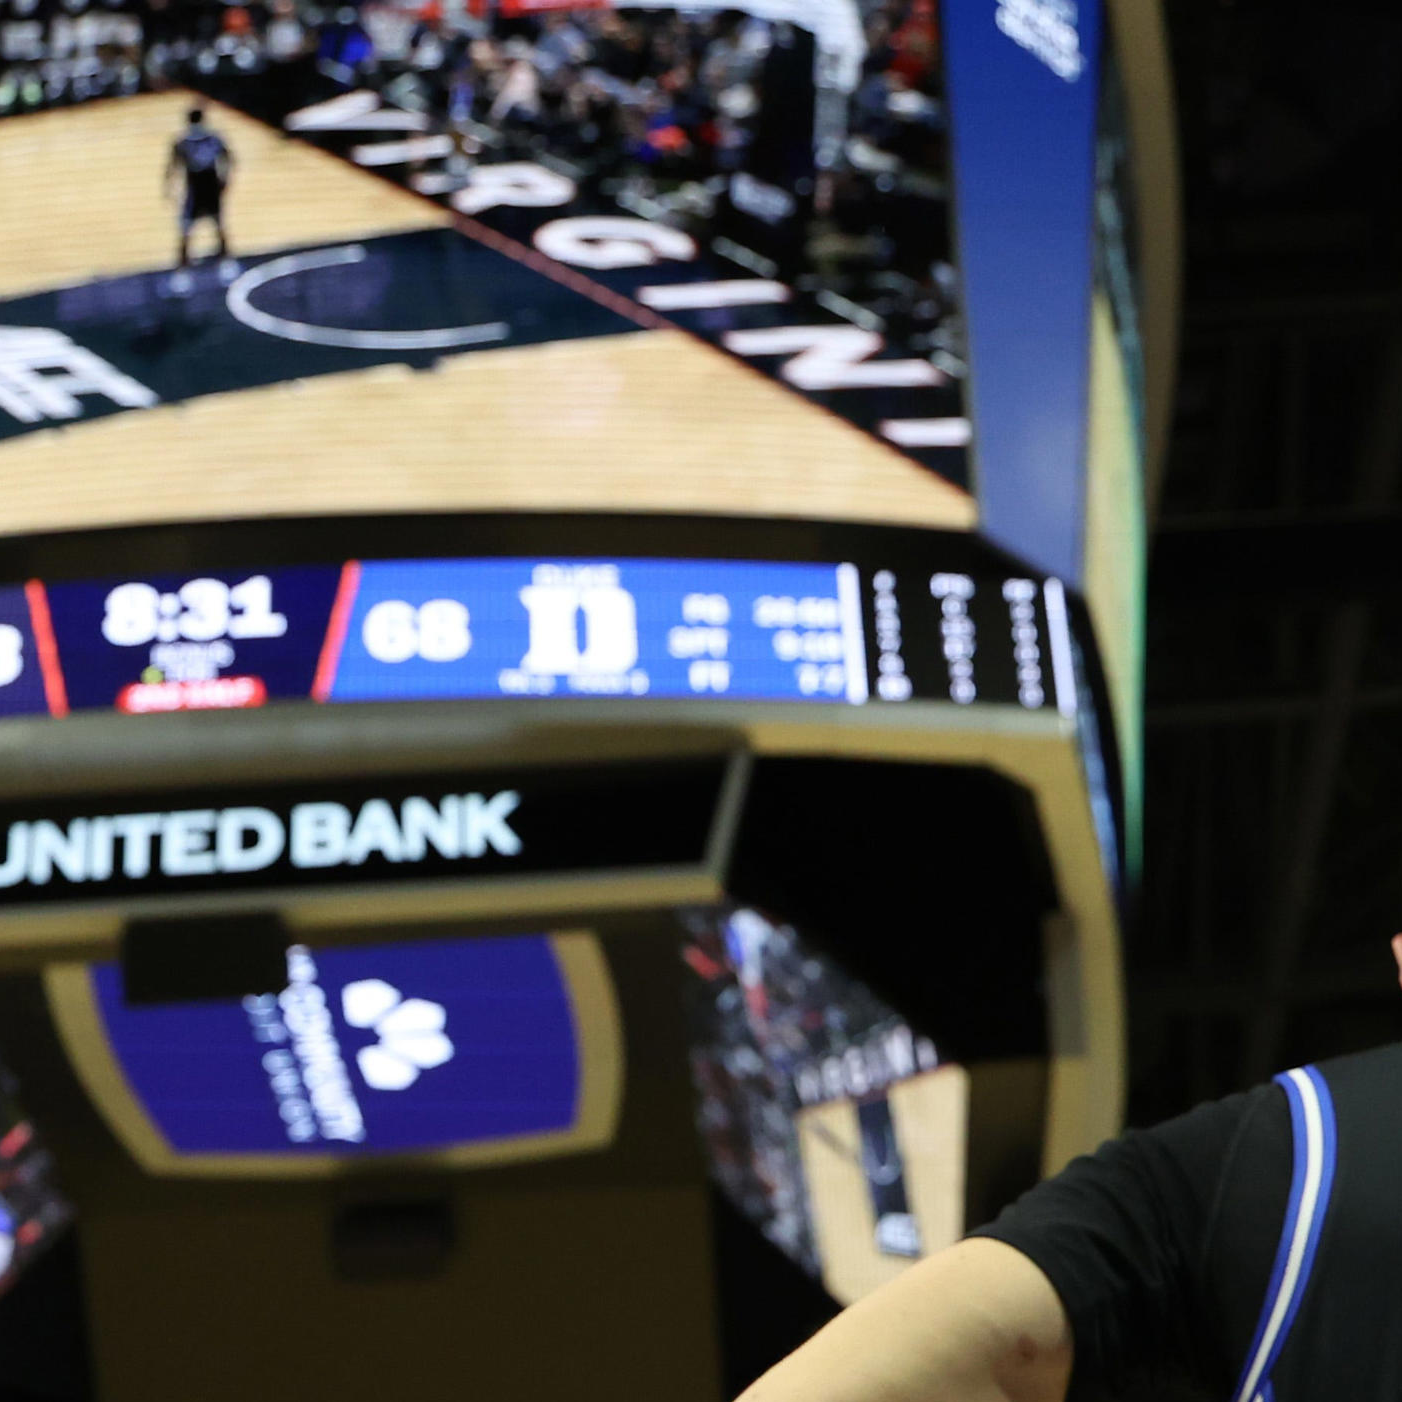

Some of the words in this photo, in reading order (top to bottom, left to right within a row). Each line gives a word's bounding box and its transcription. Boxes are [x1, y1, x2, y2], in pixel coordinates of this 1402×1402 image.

[101, 574, 288, 647] 8:31
[361, 597, 473, 664] 68
[290, 789, 523, 869] BANK
